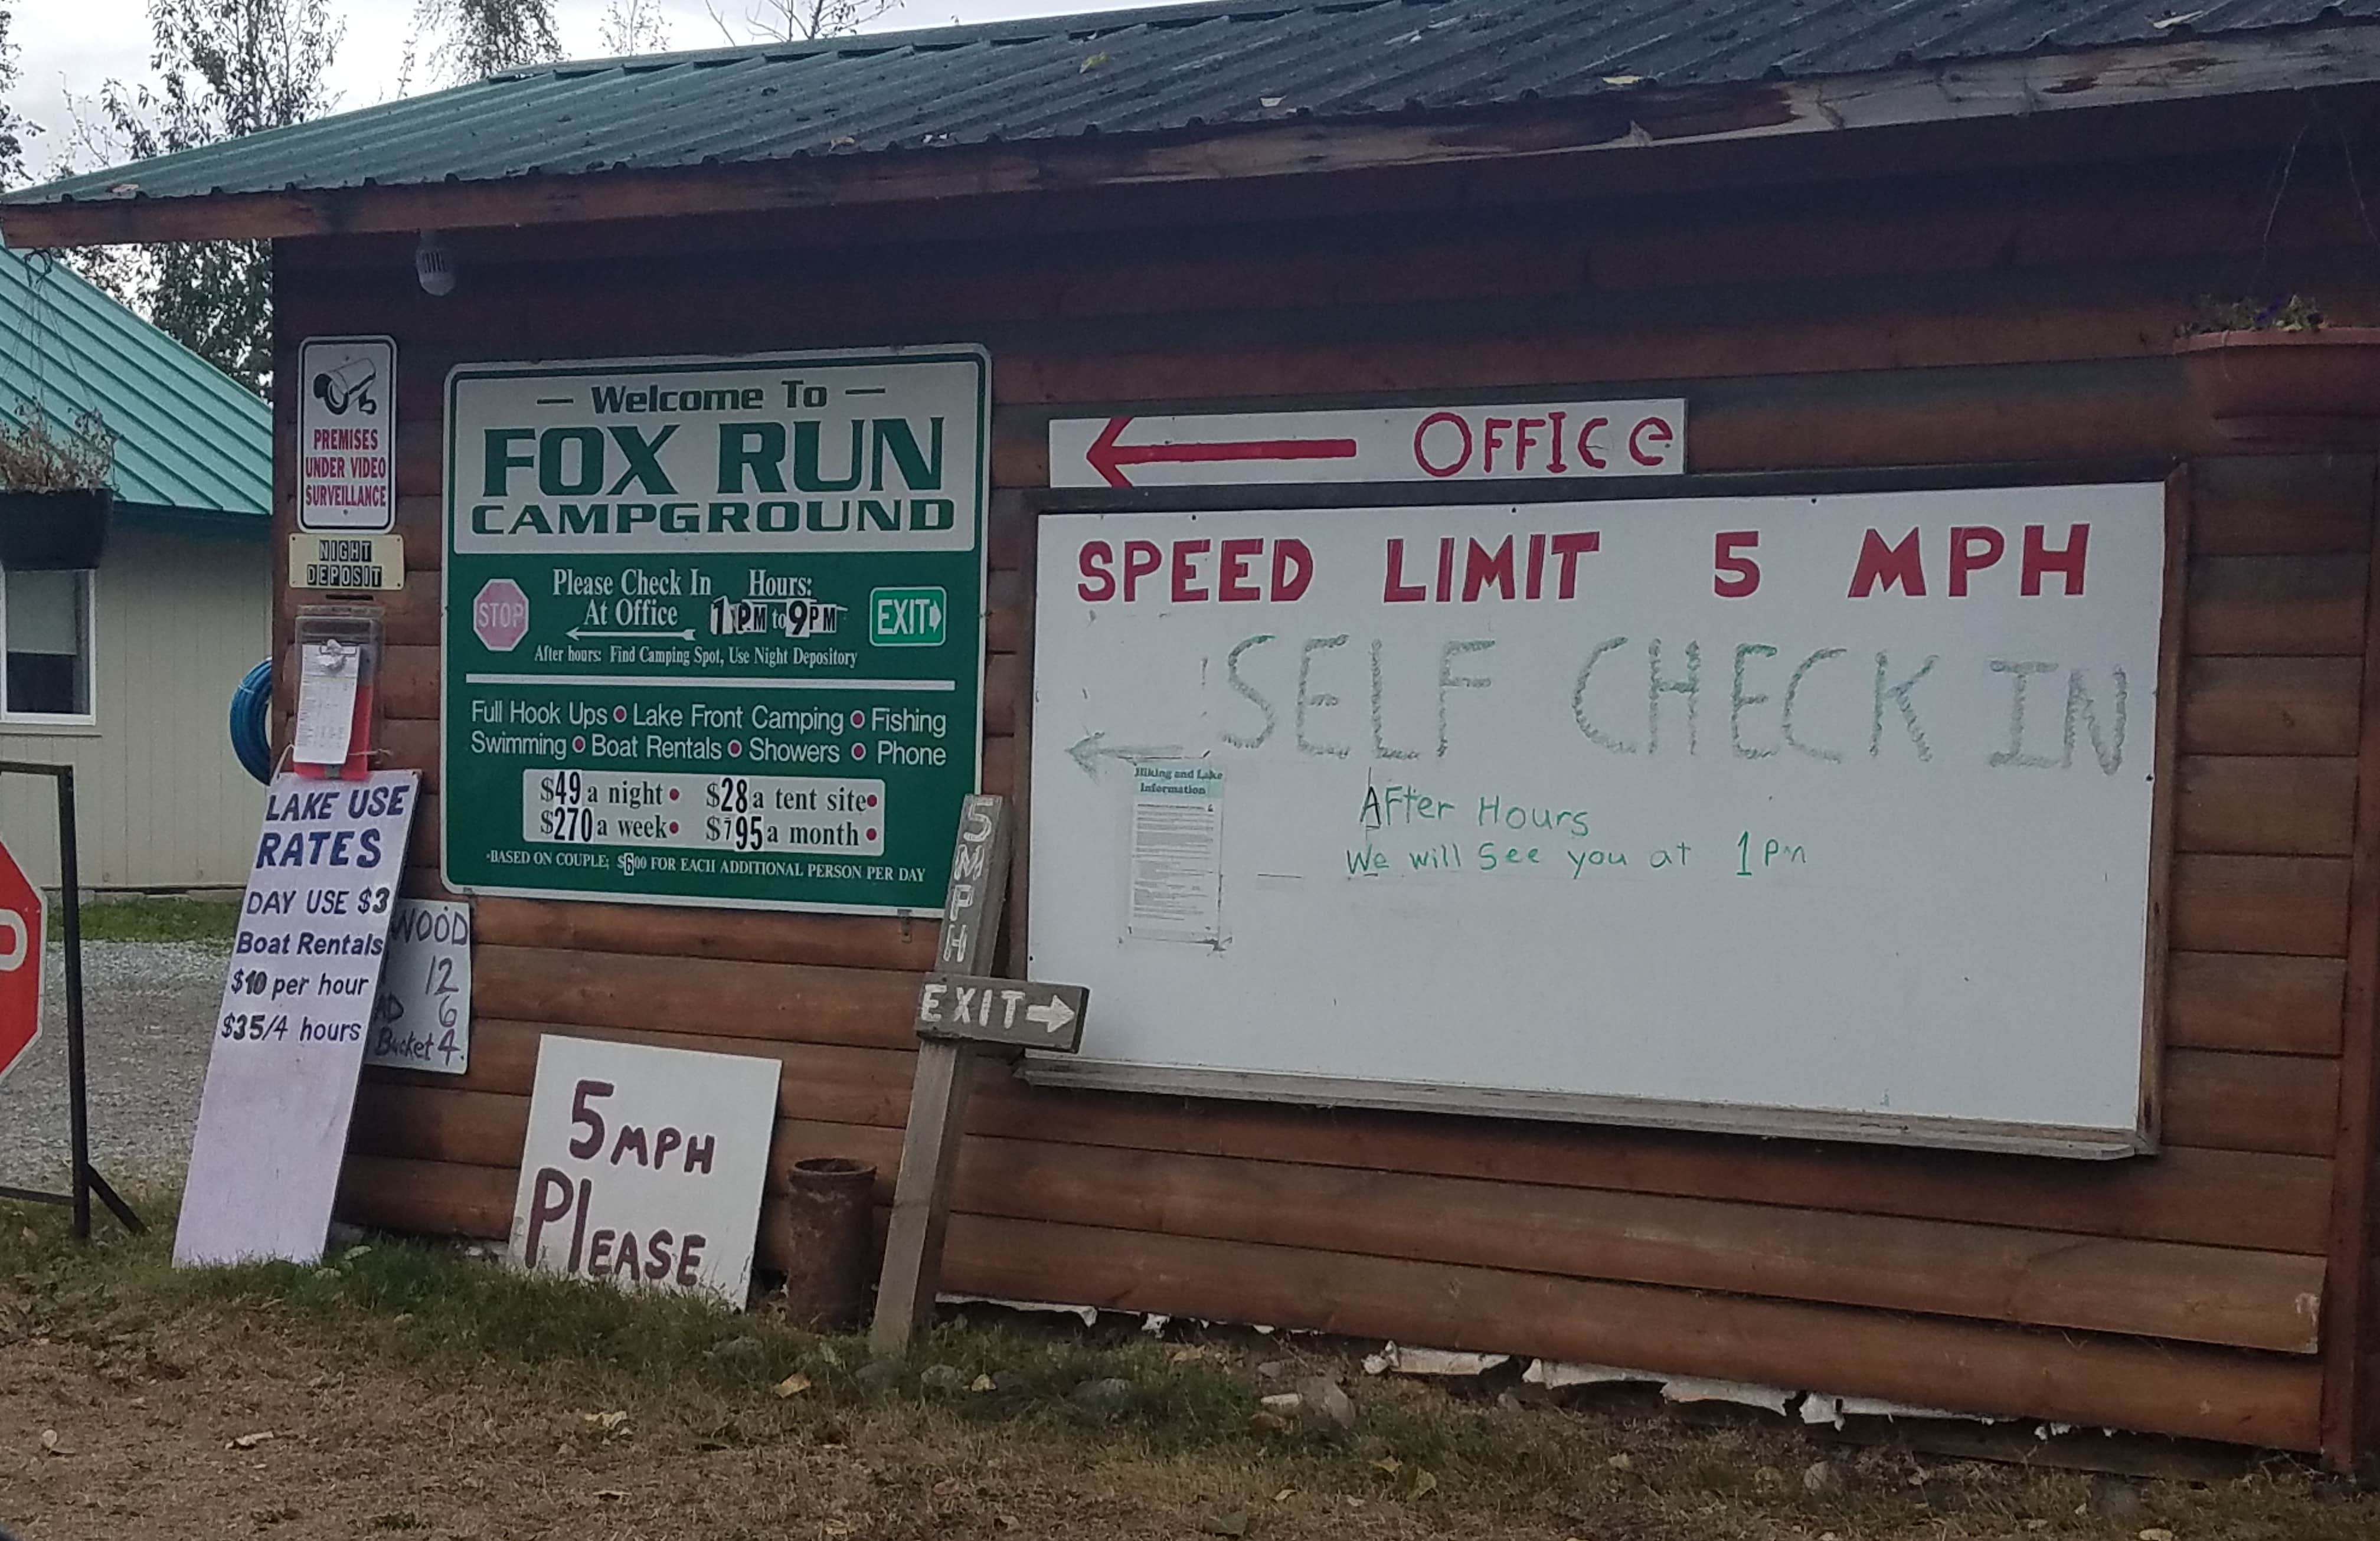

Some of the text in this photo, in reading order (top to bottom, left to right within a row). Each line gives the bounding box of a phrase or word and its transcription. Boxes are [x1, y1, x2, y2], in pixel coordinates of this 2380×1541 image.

[591, 380, 828, 414] Welcome To
[314, 429, 378, 450] PREMISES
[306, 457, 386, 478] UNDER VIDEO
[482, 417, 944, 498] FOX RUN
[306, 485, 386, 507] SURVEILLANCE
[472, 499, 954, 535] CAMPGROUND
[319, 540, 372, 562] NIGHT
[1077, 524, 2091, 604] SPEED LIMIT 5 MPH
[307, 565, 382, 587] DEPOSIT
[552, 568, 711, 596] Please Check In
[749, 569, 812, 597] Hours:
[478, 603, 524, 627] STOP
[584, 598, 678, 626] At Office
[772, 608, 786, 629] to
[878, 599, 930, 634] EXIT
[535, 645, 563, 662] After
[610, 646, 635, 663] Find
[639, 646, 690, 666] Camping
[694, 647, 724, 667] Spot,
[729, 647, 750, 665] Use
[754, 647, 788, 667] Night
[793, 647, 858, 668] Depository
[472, 701, 607, 729] Full Hook Ups
[633, 703, 844, 735] Lake Front Camping
[1220, 634, 2126, 776] SELF CHECK IN
[872, 708, 946, 737] Fishing
[471, 731, 567, 759] Swimming
[592, 734, 721, 760] Boat Rentals
[749, 738, 839, 762] Showers
[878, 741, 946, 765] Phone
[1134, 767, 1223, 780] Hiking and Lake
[265, 785, 410, 821] LAKE USE
[541, 771, 663, 809] $49 a night
[707, 777, 867, 813] $28 a tent site
[1140, 783, 1206, 794] Information
[541, 807, 667, 842] $270 a week
[1479, 794, 1588, 836] Hours
[707, 816, 859, 850] $795 a month
[256, 828, 381, 869] RATES
[1347, 843, 1389, 875] We
[1409, 843, 1461, 870] will
[1567, 850, 1627, 879] you
[1650, 842, 1691, 868] at
[534, 852, 552, 865] ON
[651, 857, 676, 872] FOR
[681, 858, 715, 873] EACH
[720, 861, 803, 877] ADDITIONAL
[808, 864, 862, 879] PERSON
[867, 866, 893, 881] PER
[899, 867, 926, 882] DAY
[246, 886, 390, 914] DAY USE $3
[236, 931, 383, 956] Boat Rentals
[231, 969, 370, 1000] $10 per hour
[425, 955, 459, 996] 12
[921, 983, 1026, 1029] EXIT
[221, 1012, 361, 1042] $35/4 hours
[374, 1026, 434, 1061] Bucket
